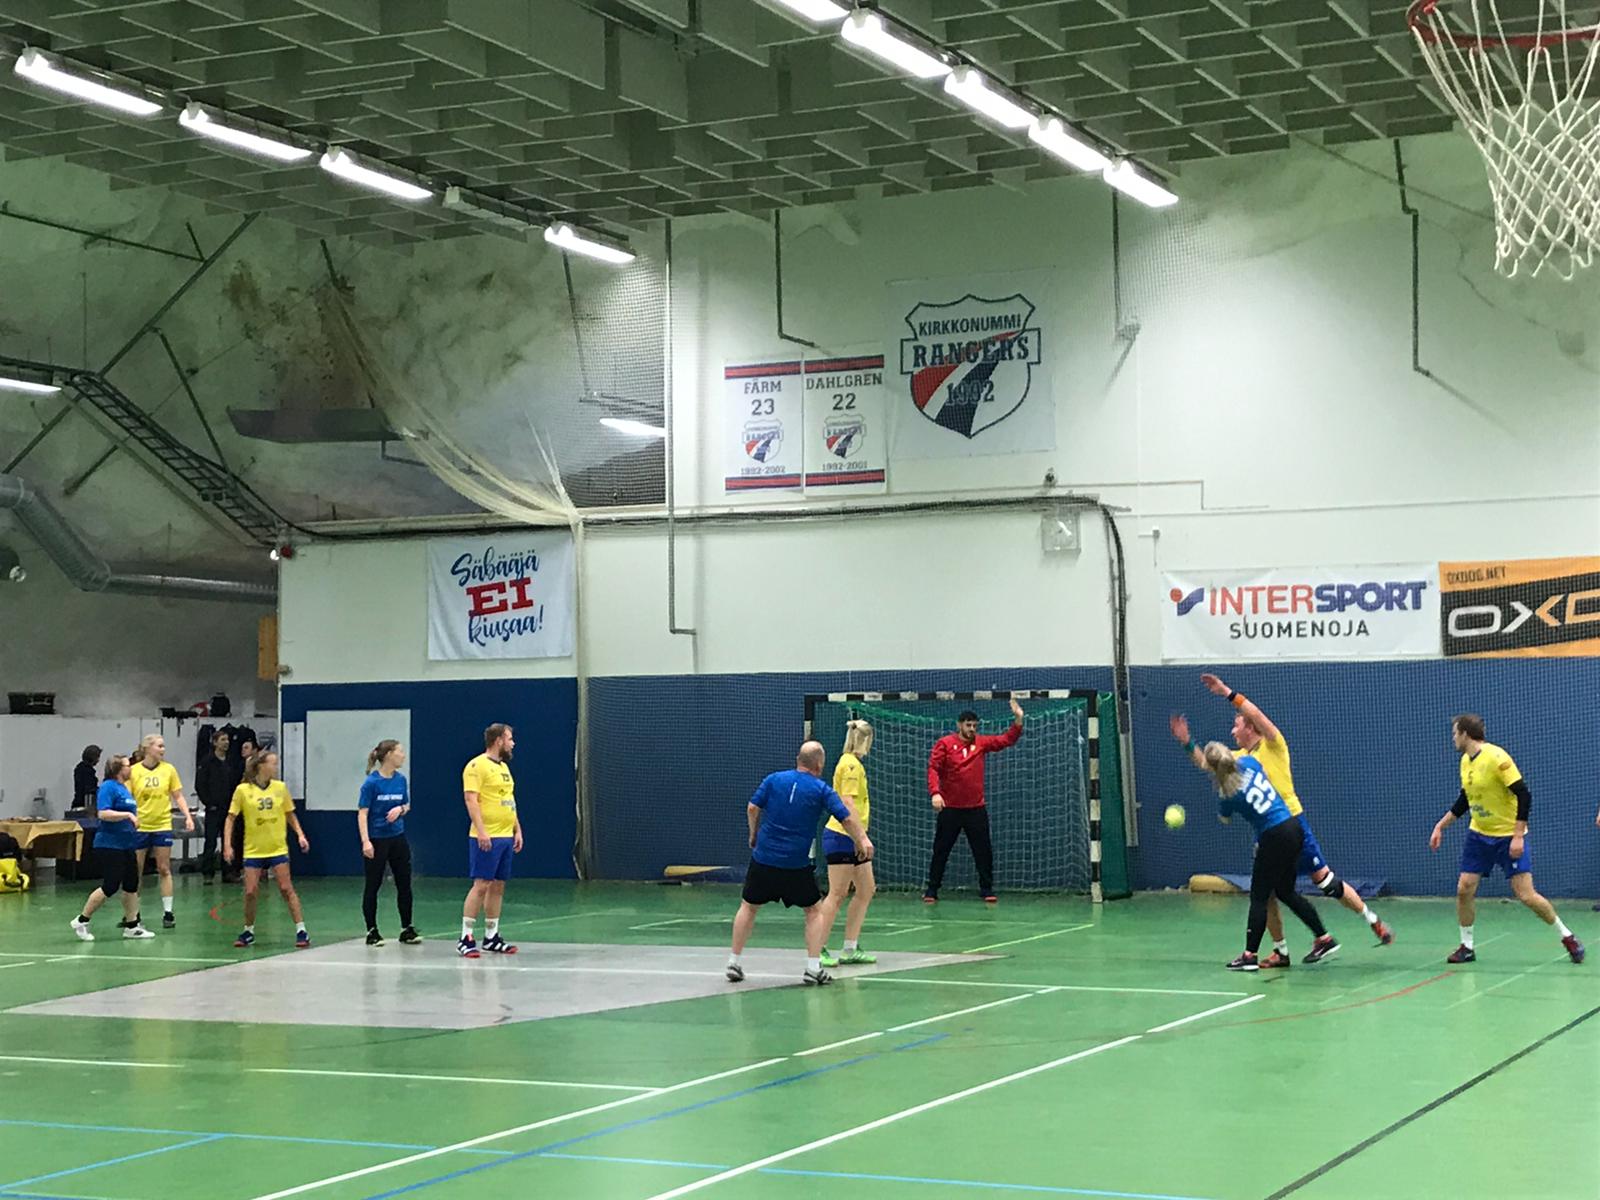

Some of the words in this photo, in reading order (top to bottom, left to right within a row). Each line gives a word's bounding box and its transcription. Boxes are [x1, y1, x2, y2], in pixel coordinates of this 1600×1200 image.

[918, 313, 1021, 336] KIRKKONUMMI
[913, 336, 1029, 368] RANGERS
[744, 378, 782, 394] FÄRM
[806, 373, 883, 390] DAHLGREN
[945, 379, 995, 406] 1992
[751, 398, 775, 416] 23
[832, 393, 856, 411] 22
[451, 546, 539, 587] Säbääjä
[466, 577, 534, 617] EI
[1210, 581, 1427, 616] INTERSPORT
[468, 605, 544, 647] kiusaa!
[1229, 619, 1370, 640] SUOMENOJA
[144, 776, 160, 788] 20
[1246, 771, 1276, 815] 25
[256, 797, 273, 811] 39
